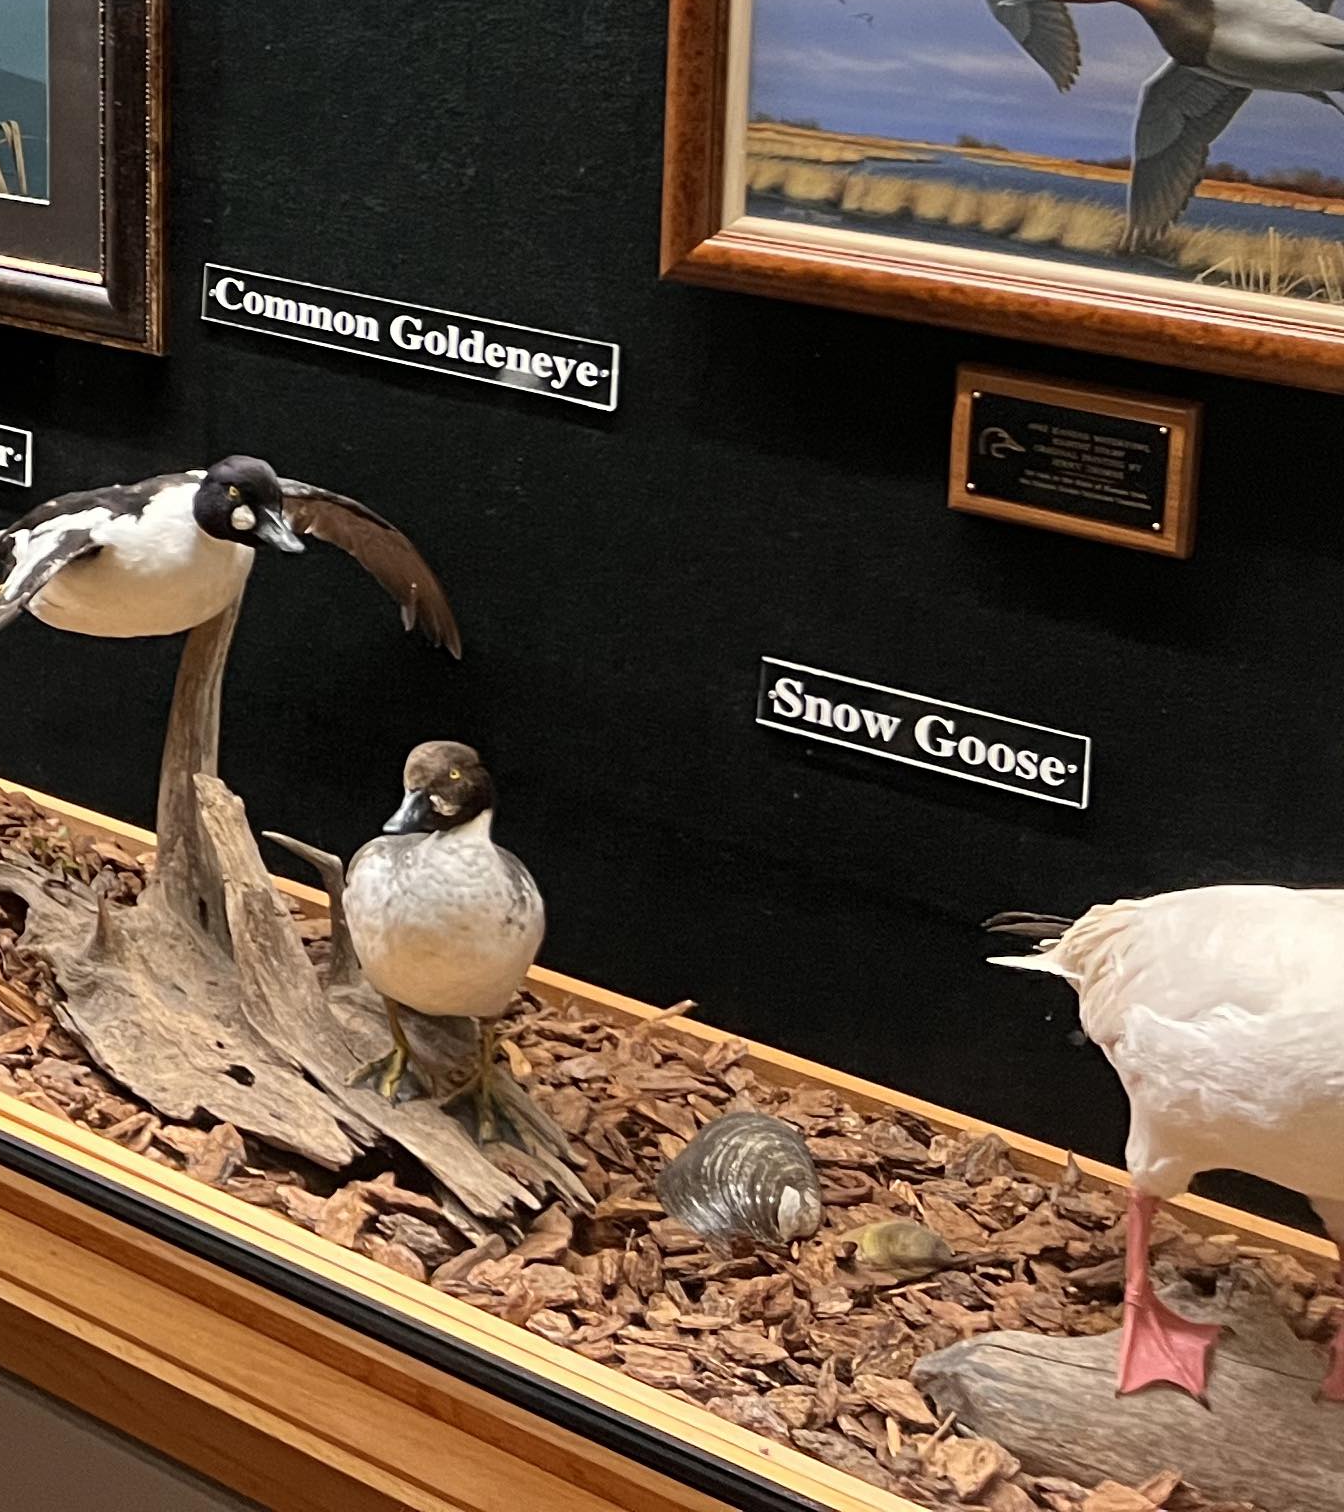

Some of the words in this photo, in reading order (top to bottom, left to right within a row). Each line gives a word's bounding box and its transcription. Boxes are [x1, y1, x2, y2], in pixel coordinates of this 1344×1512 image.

[214, 276, 380, 342] Common
[389, 314, 599, 390] Goldeneye
[772, 677, 902, 742] Snow
[914, 714, 1067, 787] Goose
